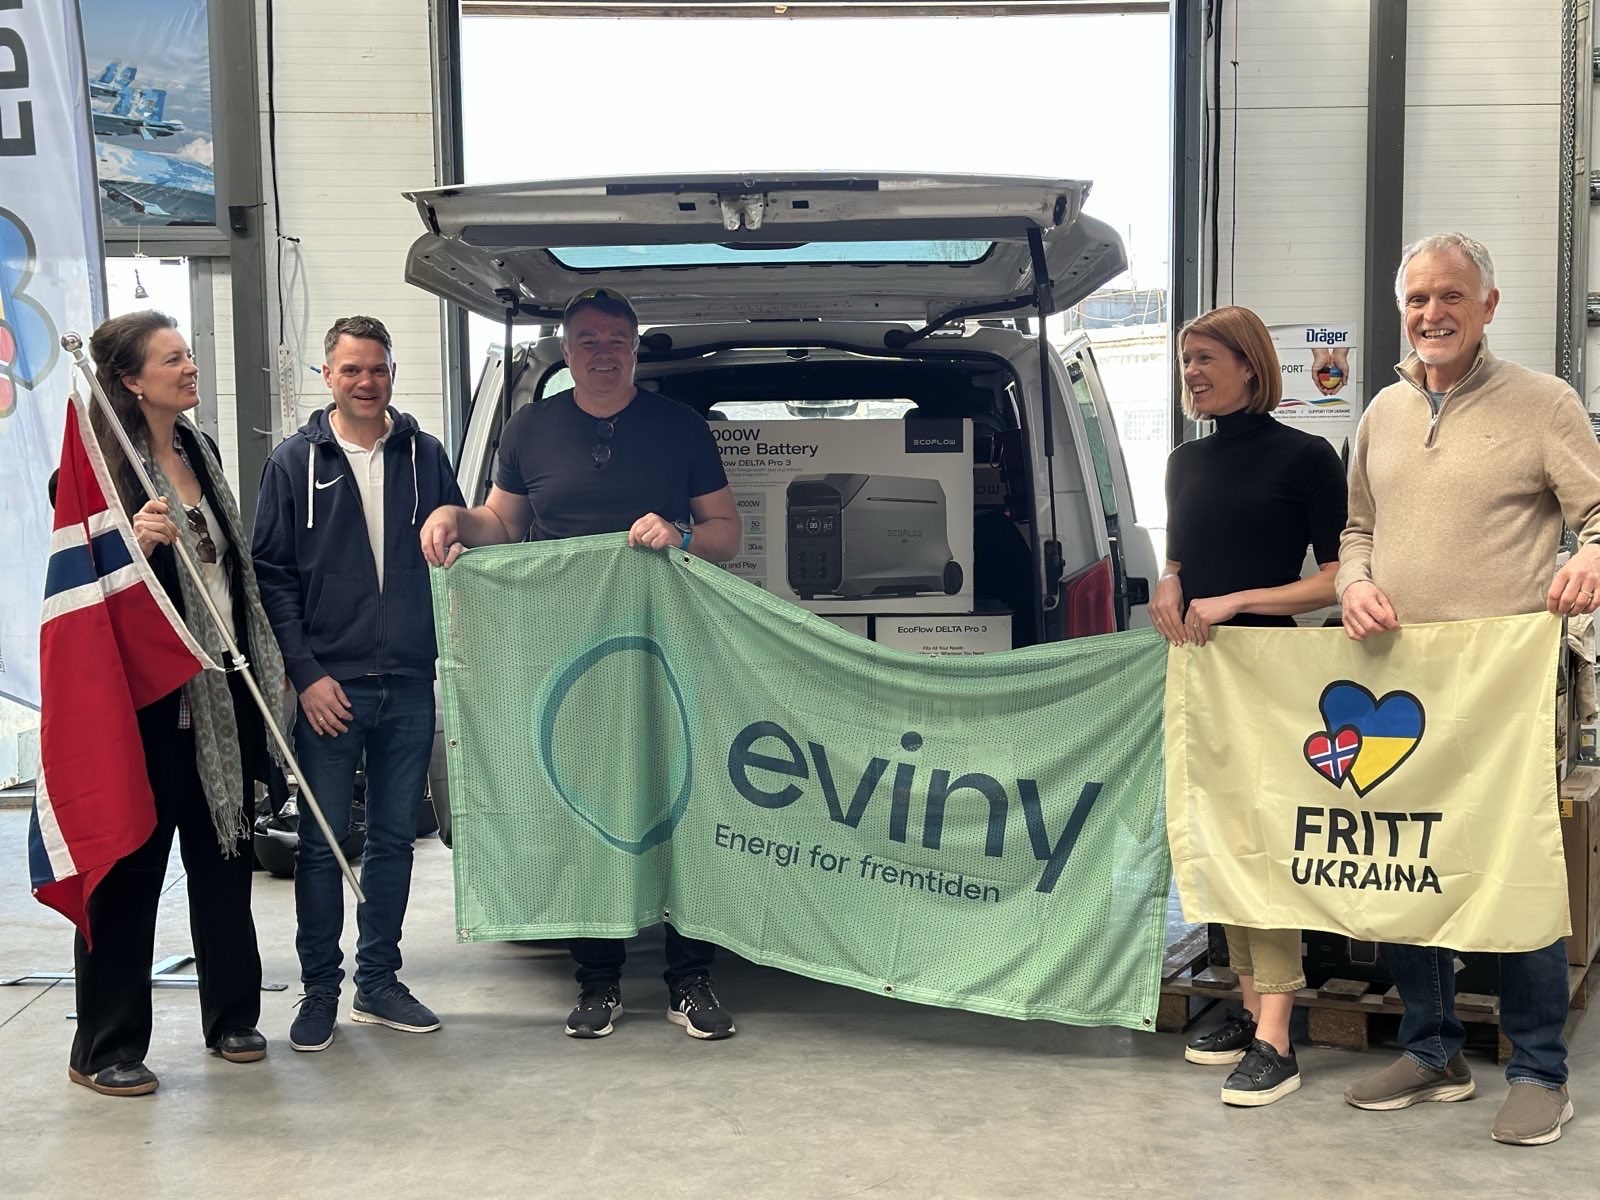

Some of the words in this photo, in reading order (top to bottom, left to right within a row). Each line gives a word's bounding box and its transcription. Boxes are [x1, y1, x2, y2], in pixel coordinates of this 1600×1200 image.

[1306, 328, 1348, 345] Dräger
[1281, 364, 1304, 373] PORT
[712, 428, 760, 441] 000W
[717, 445, 750, 455] ome
[756, 443, 819, 457] Battery
[739, 459, 766, 467] DELTA
[728, 561, 741, 569] and
[742, 561, 757, 570] Play
[935, 625, 962, 633] DELTA
[964, 625, 979, 633] Pro
[981, 625, 987, 633] 3
[727, 720, 1103, 893] eviny
[1294, 806, 1443, 859] FRITT
[714, 822, 799, 866] Energi
[809, 844, 850, 873] for
[860, 854, 1000, 903] fremtiden
[1291, 857, 1443, 894] UKRAINA
